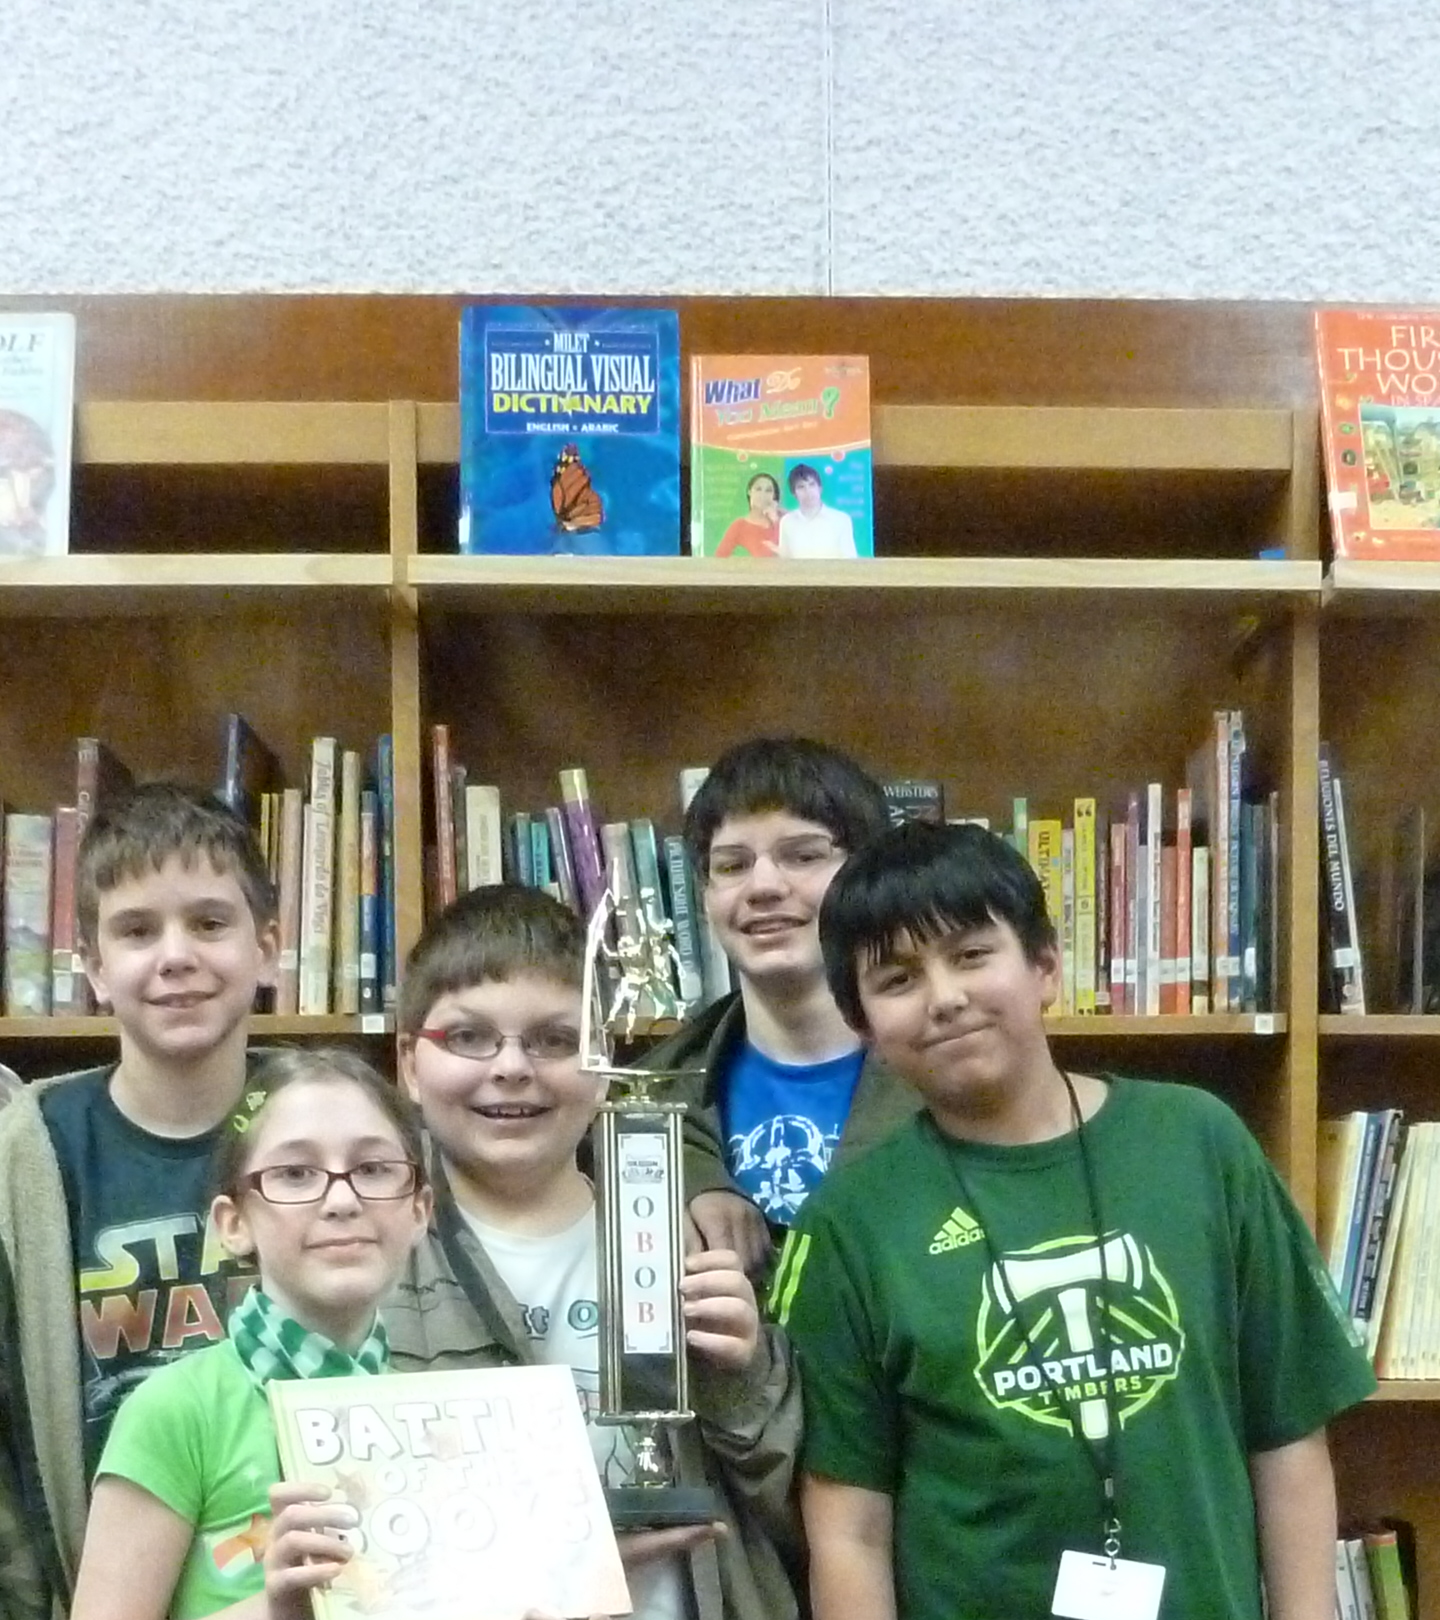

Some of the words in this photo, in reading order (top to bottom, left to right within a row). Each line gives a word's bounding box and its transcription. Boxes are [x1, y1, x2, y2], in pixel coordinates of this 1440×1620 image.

[553, 333, 590, 353] MILET
[490, 353, 588, 391] BILINGUAL
[590, 354, 655, 393] VISUAL
[704, 378, 761, 405] What
[765, 367, 802, 394] Do
[526, 422, 570, 433] ENGLISH
[581, 423, 619, 433] ARABIC
[314, 802, 331, 817] of
[1318, 760, 1337, 831] RELIGIONES
[314, 822, 332, 881] Leonardo
[1326, 834, 1340, 858] DEL
[667, 841, 690, 915] PICTURESQUE
[1330, 860, 1345, 912] MUNDO
[313, 902, 328, 934] Vinci
[677, 920, 693, 956] WORD
[80, 1212, 254, 1293] ST
[80, 1275, 262, 1359] WA
[993, 1343, 1174, 1396] PORTLAND
[1037, 1375, 1142, 1405] TMBERS
[295, 1395, 565, 1466] BATTLE
[374, 1460, 428, 1495] OF
